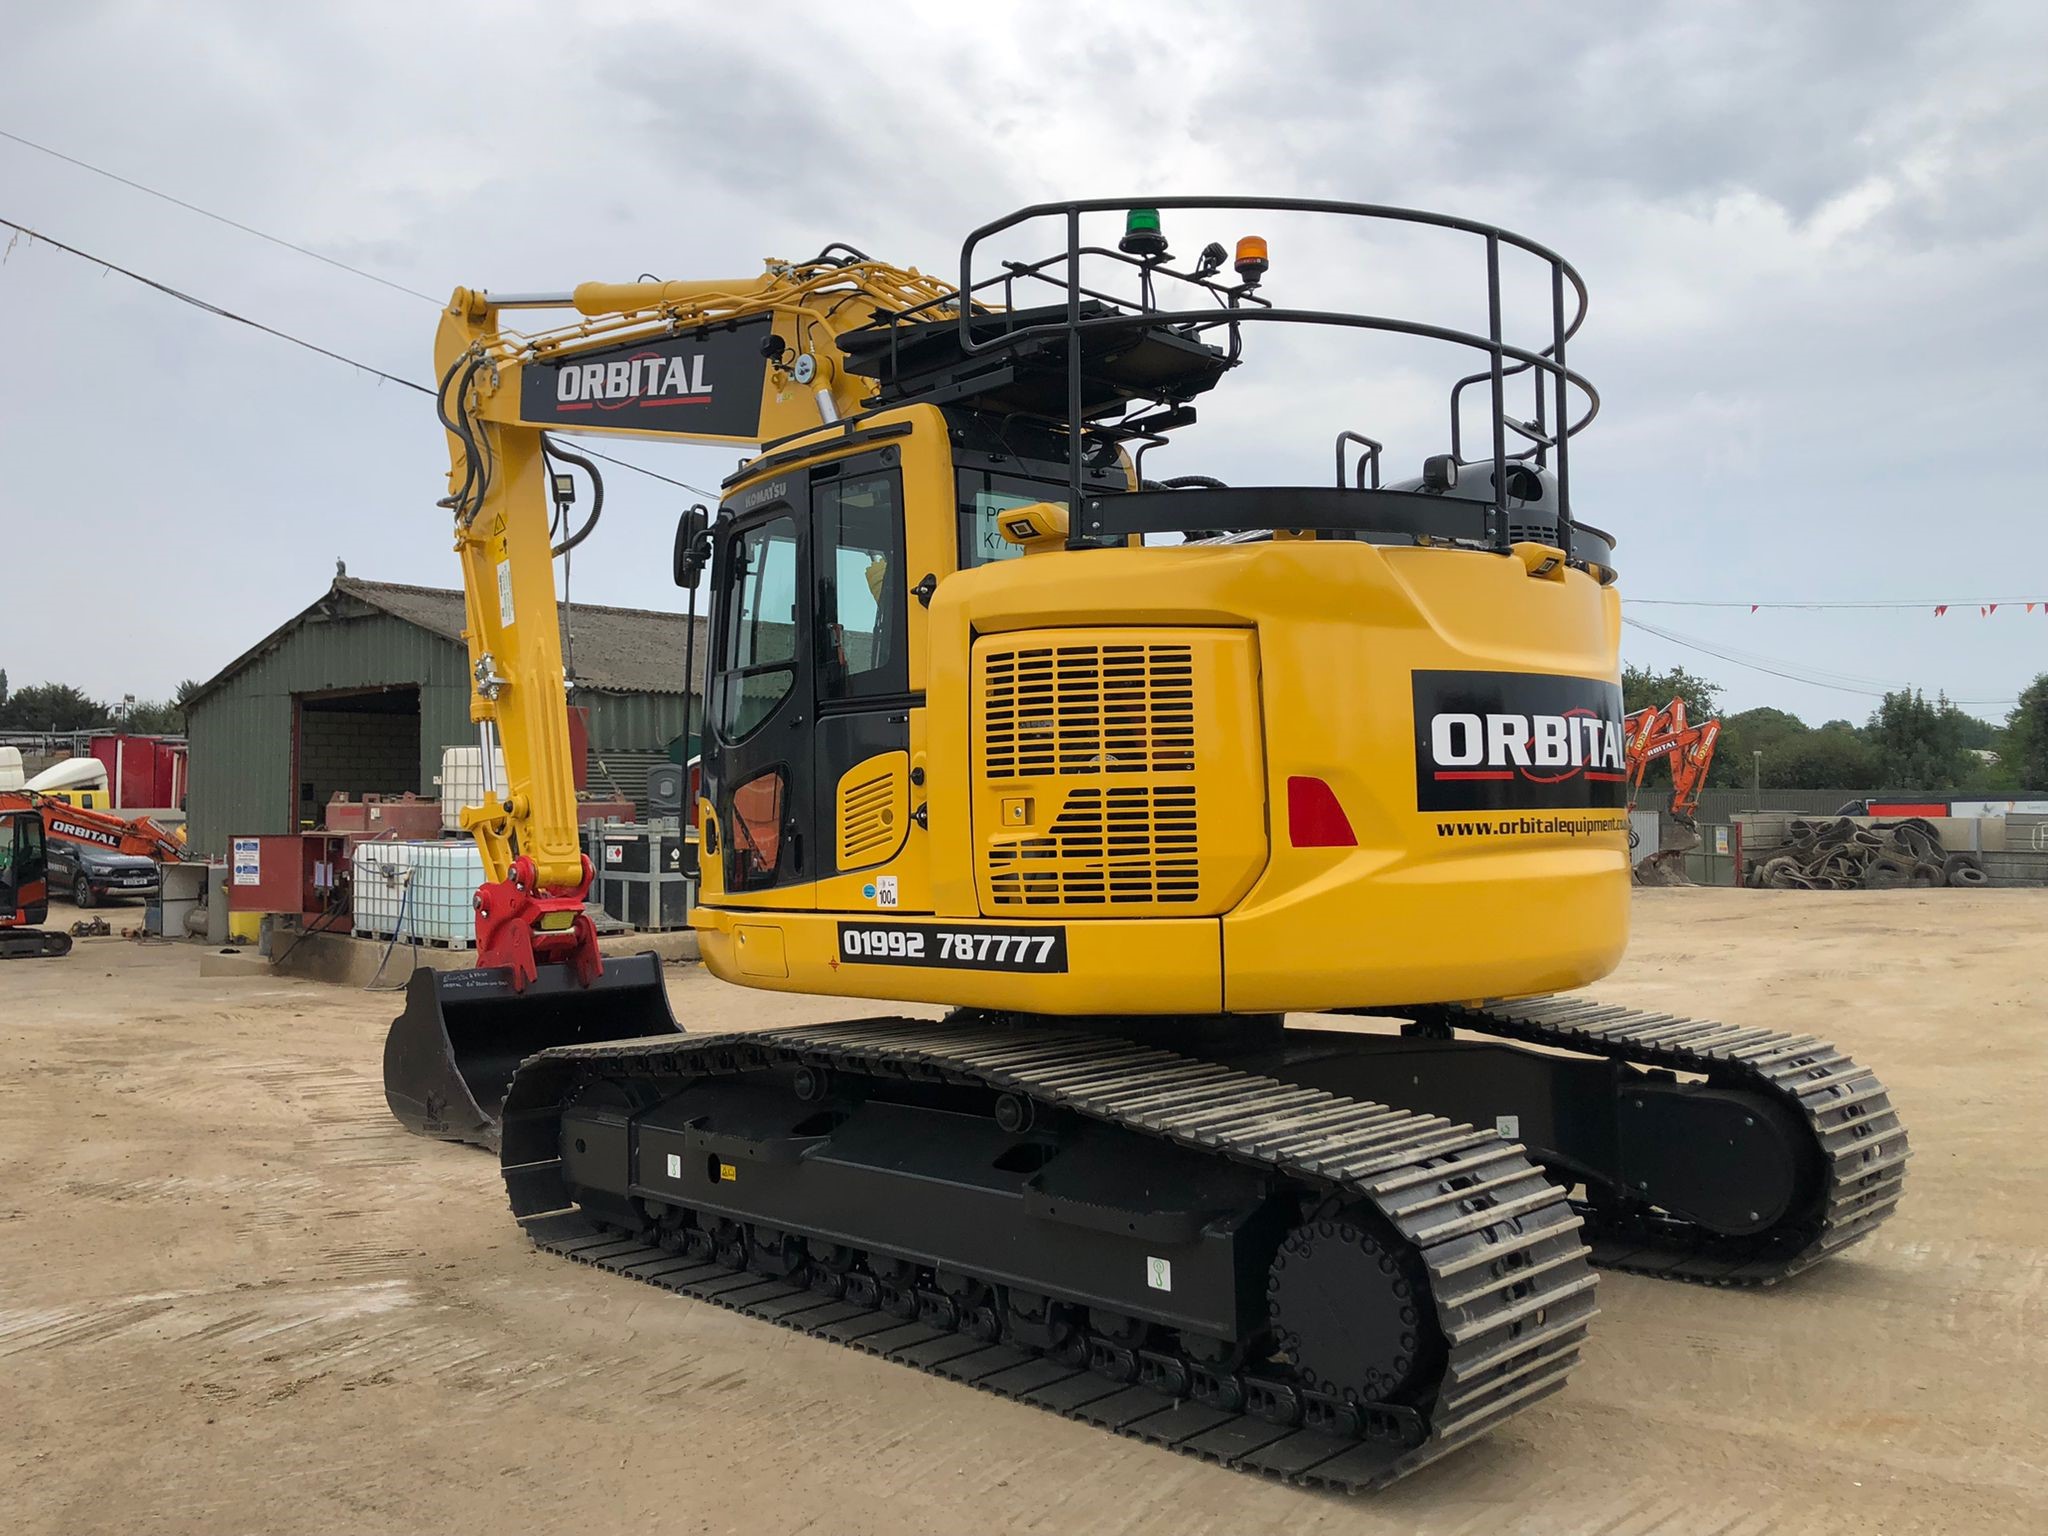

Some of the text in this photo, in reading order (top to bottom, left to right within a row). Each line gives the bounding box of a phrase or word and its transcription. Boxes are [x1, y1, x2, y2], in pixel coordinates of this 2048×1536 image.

[557, 354, 713, 402] ORBITAL
[744, 482, 787, 508] KOMATSU
[1431, 713, 1626, 770] ORBITAL
[1647, 740, 1678, 756] RBITAL
[52, 820, 117, 846] ORBITAL
[843, 930, 1056, 963] 01992 787777
